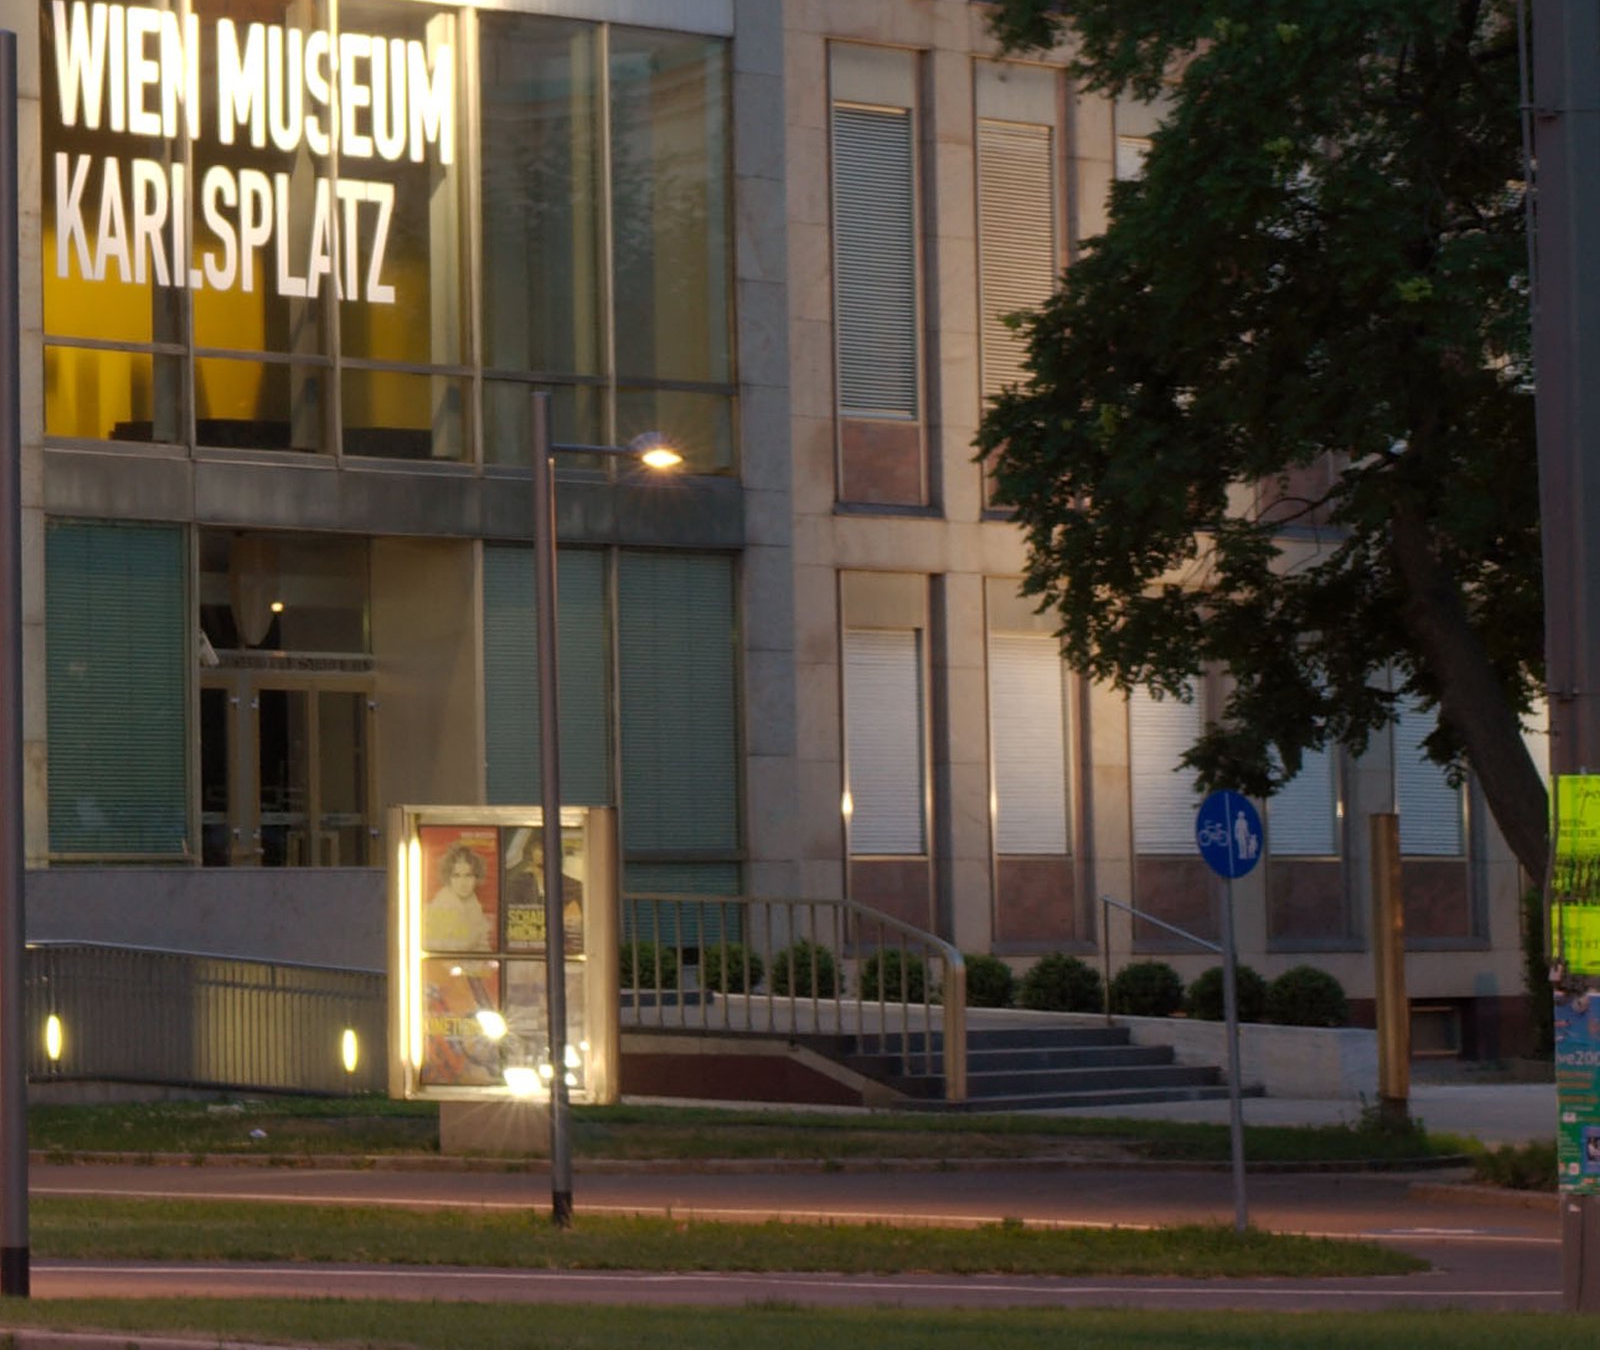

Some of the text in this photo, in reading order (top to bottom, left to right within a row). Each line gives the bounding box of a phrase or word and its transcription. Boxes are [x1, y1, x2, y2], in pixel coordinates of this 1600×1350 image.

[52, 0, 455, 165] WIEN MUSEUM
[55, 152, 396, 304] KARLSPLATZ
